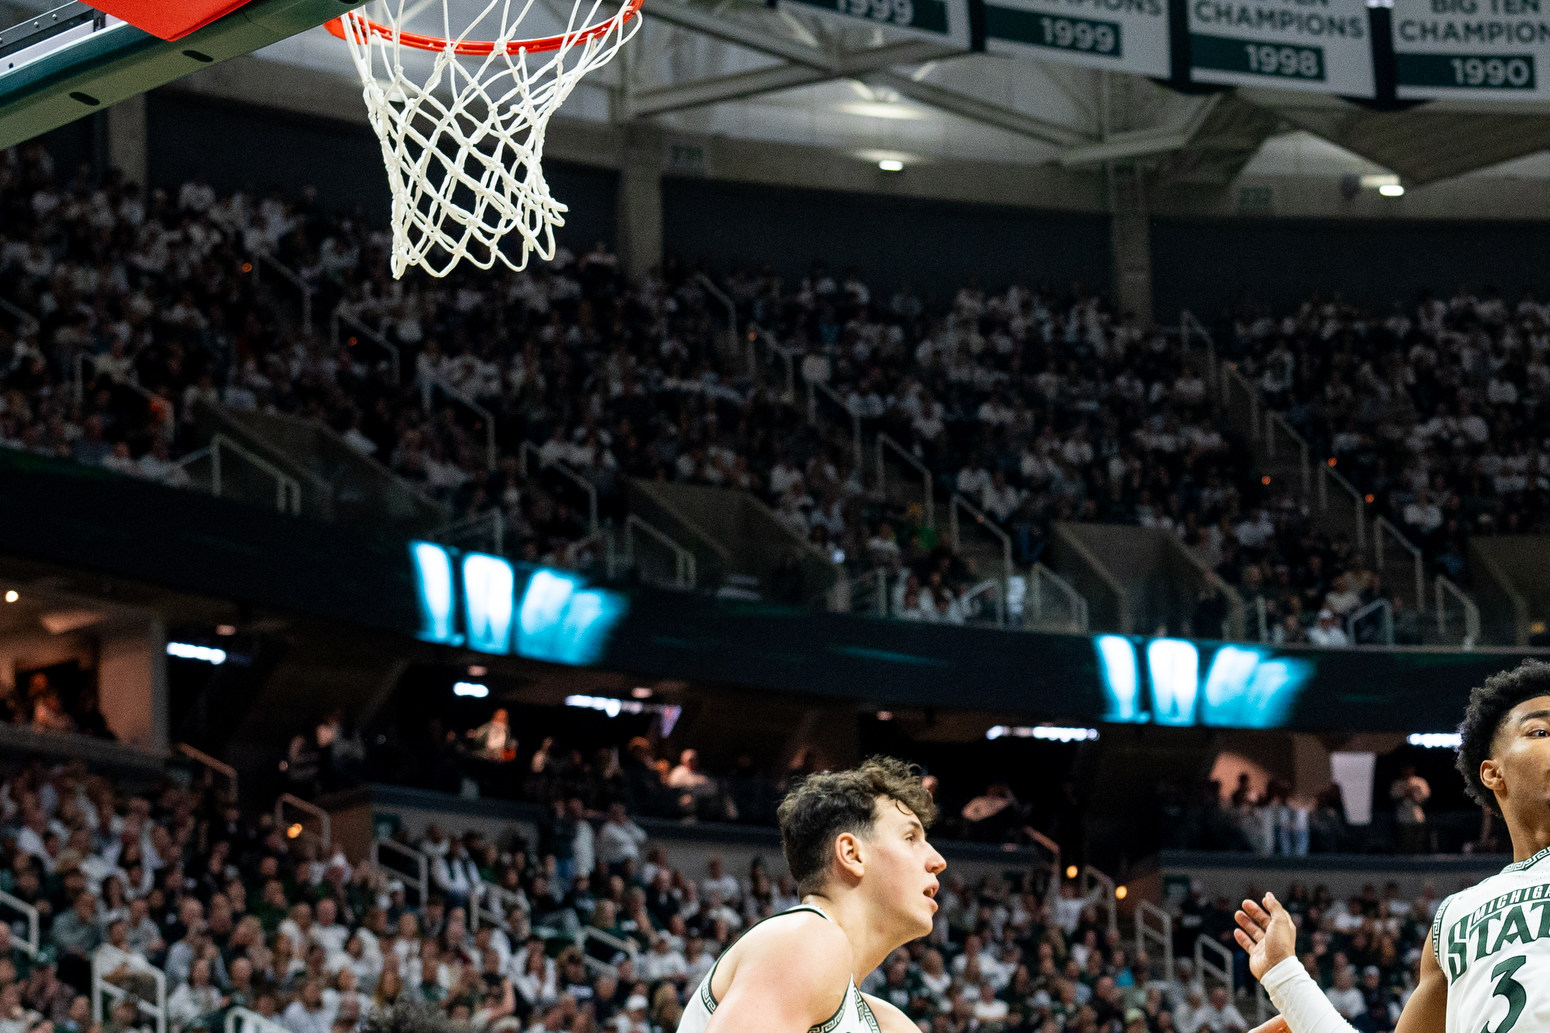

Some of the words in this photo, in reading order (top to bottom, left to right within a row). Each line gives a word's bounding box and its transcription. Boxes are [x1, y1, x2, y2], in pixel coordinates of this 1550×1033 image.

[1040, 17, 1114, 52] 1999
[1195, 0, 1365, 39] CHAMPIONS
[1246, 45, 1319, 77] 1998
[1451, 58, 1531, 86] 1990
